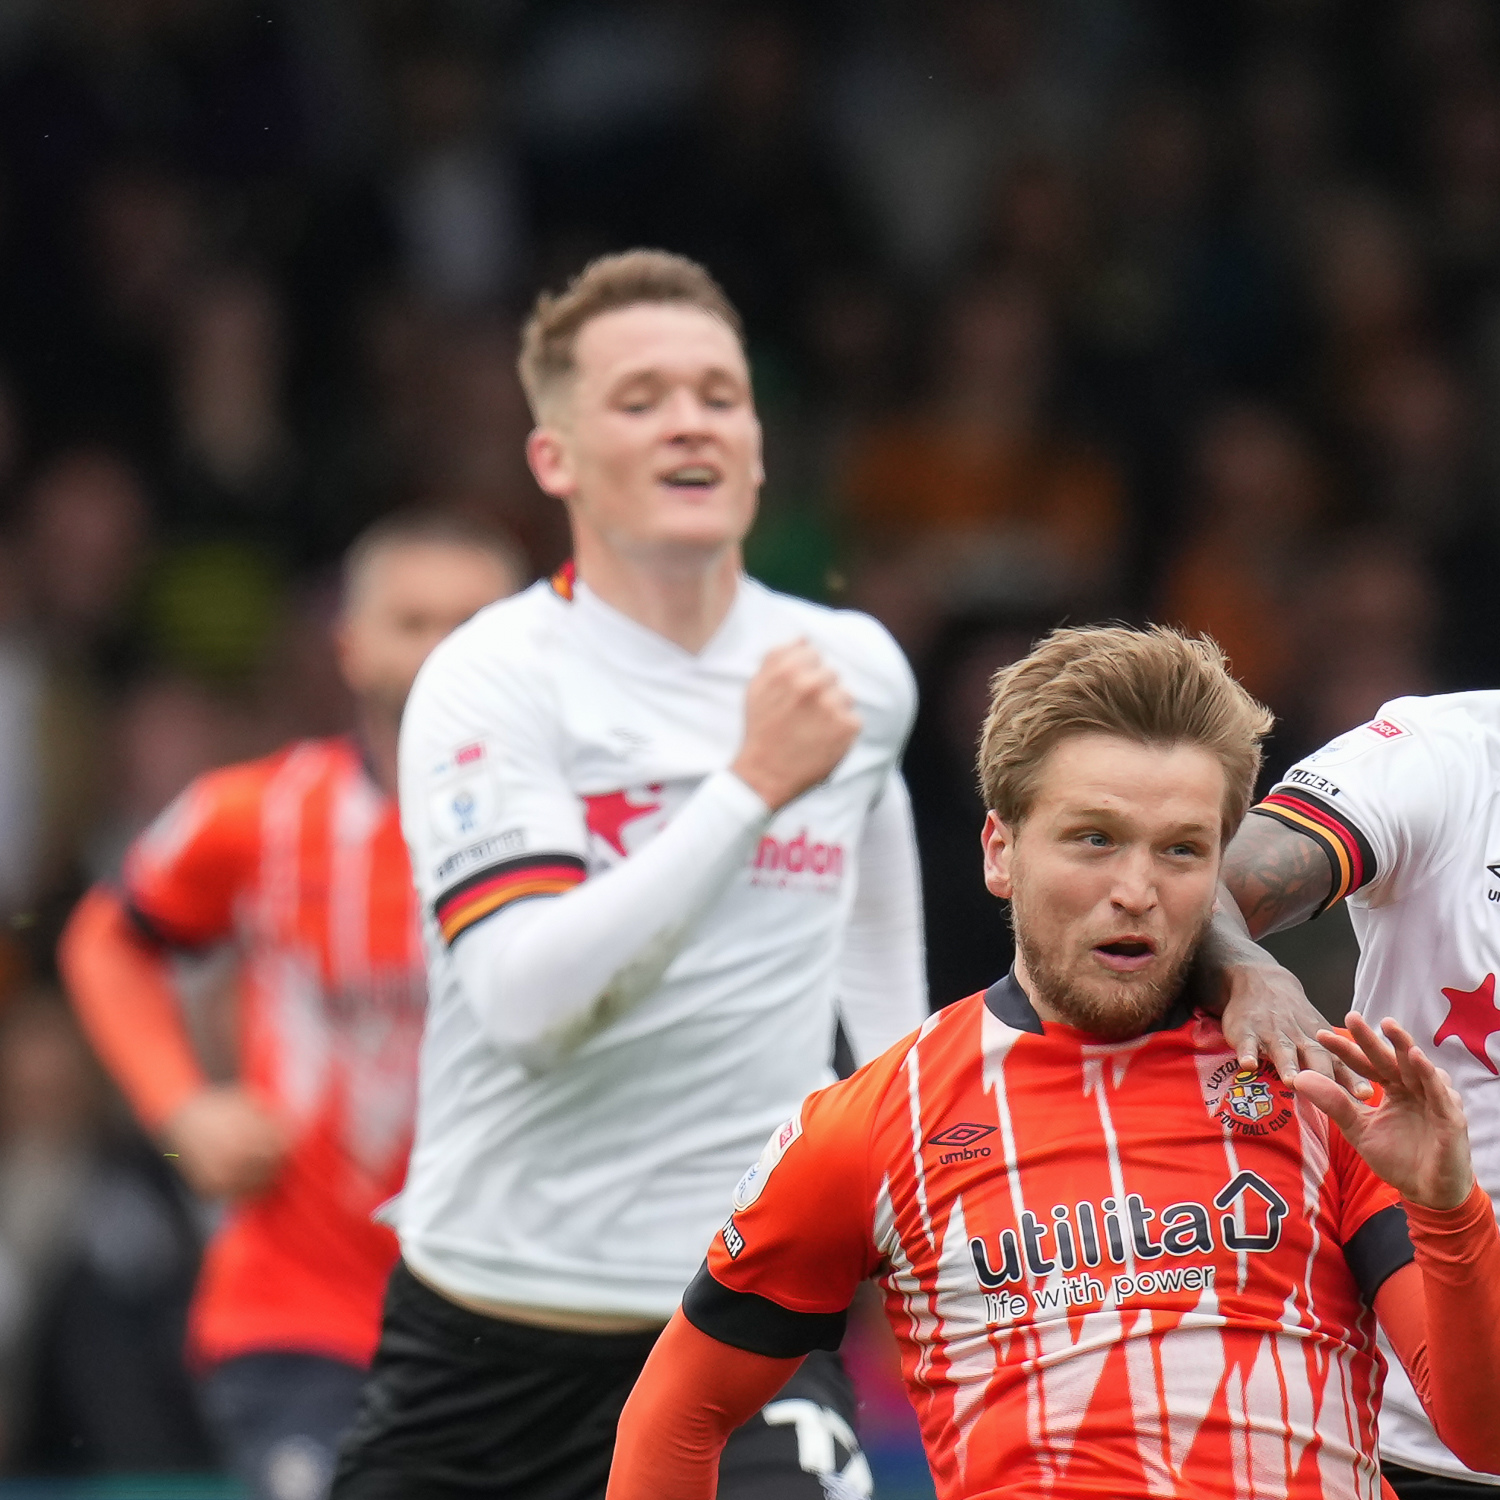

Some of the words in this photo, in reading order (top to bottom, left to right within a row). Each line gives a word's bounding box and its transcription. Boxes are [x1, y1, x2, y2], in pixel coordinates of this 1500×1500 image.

[1214, 1111, 1269, 1136] FOOTBALL
[1268, 1108, 1292, 1132] CLUB
[939, 1147, 992, 1165] umbro
[968, 1193, 1214, 1289] utilita
[984, 1292, 1028, 1325] life
[1034, 1271, 1105, 1309] with
[1112, 1265, 1216, 1306] power
